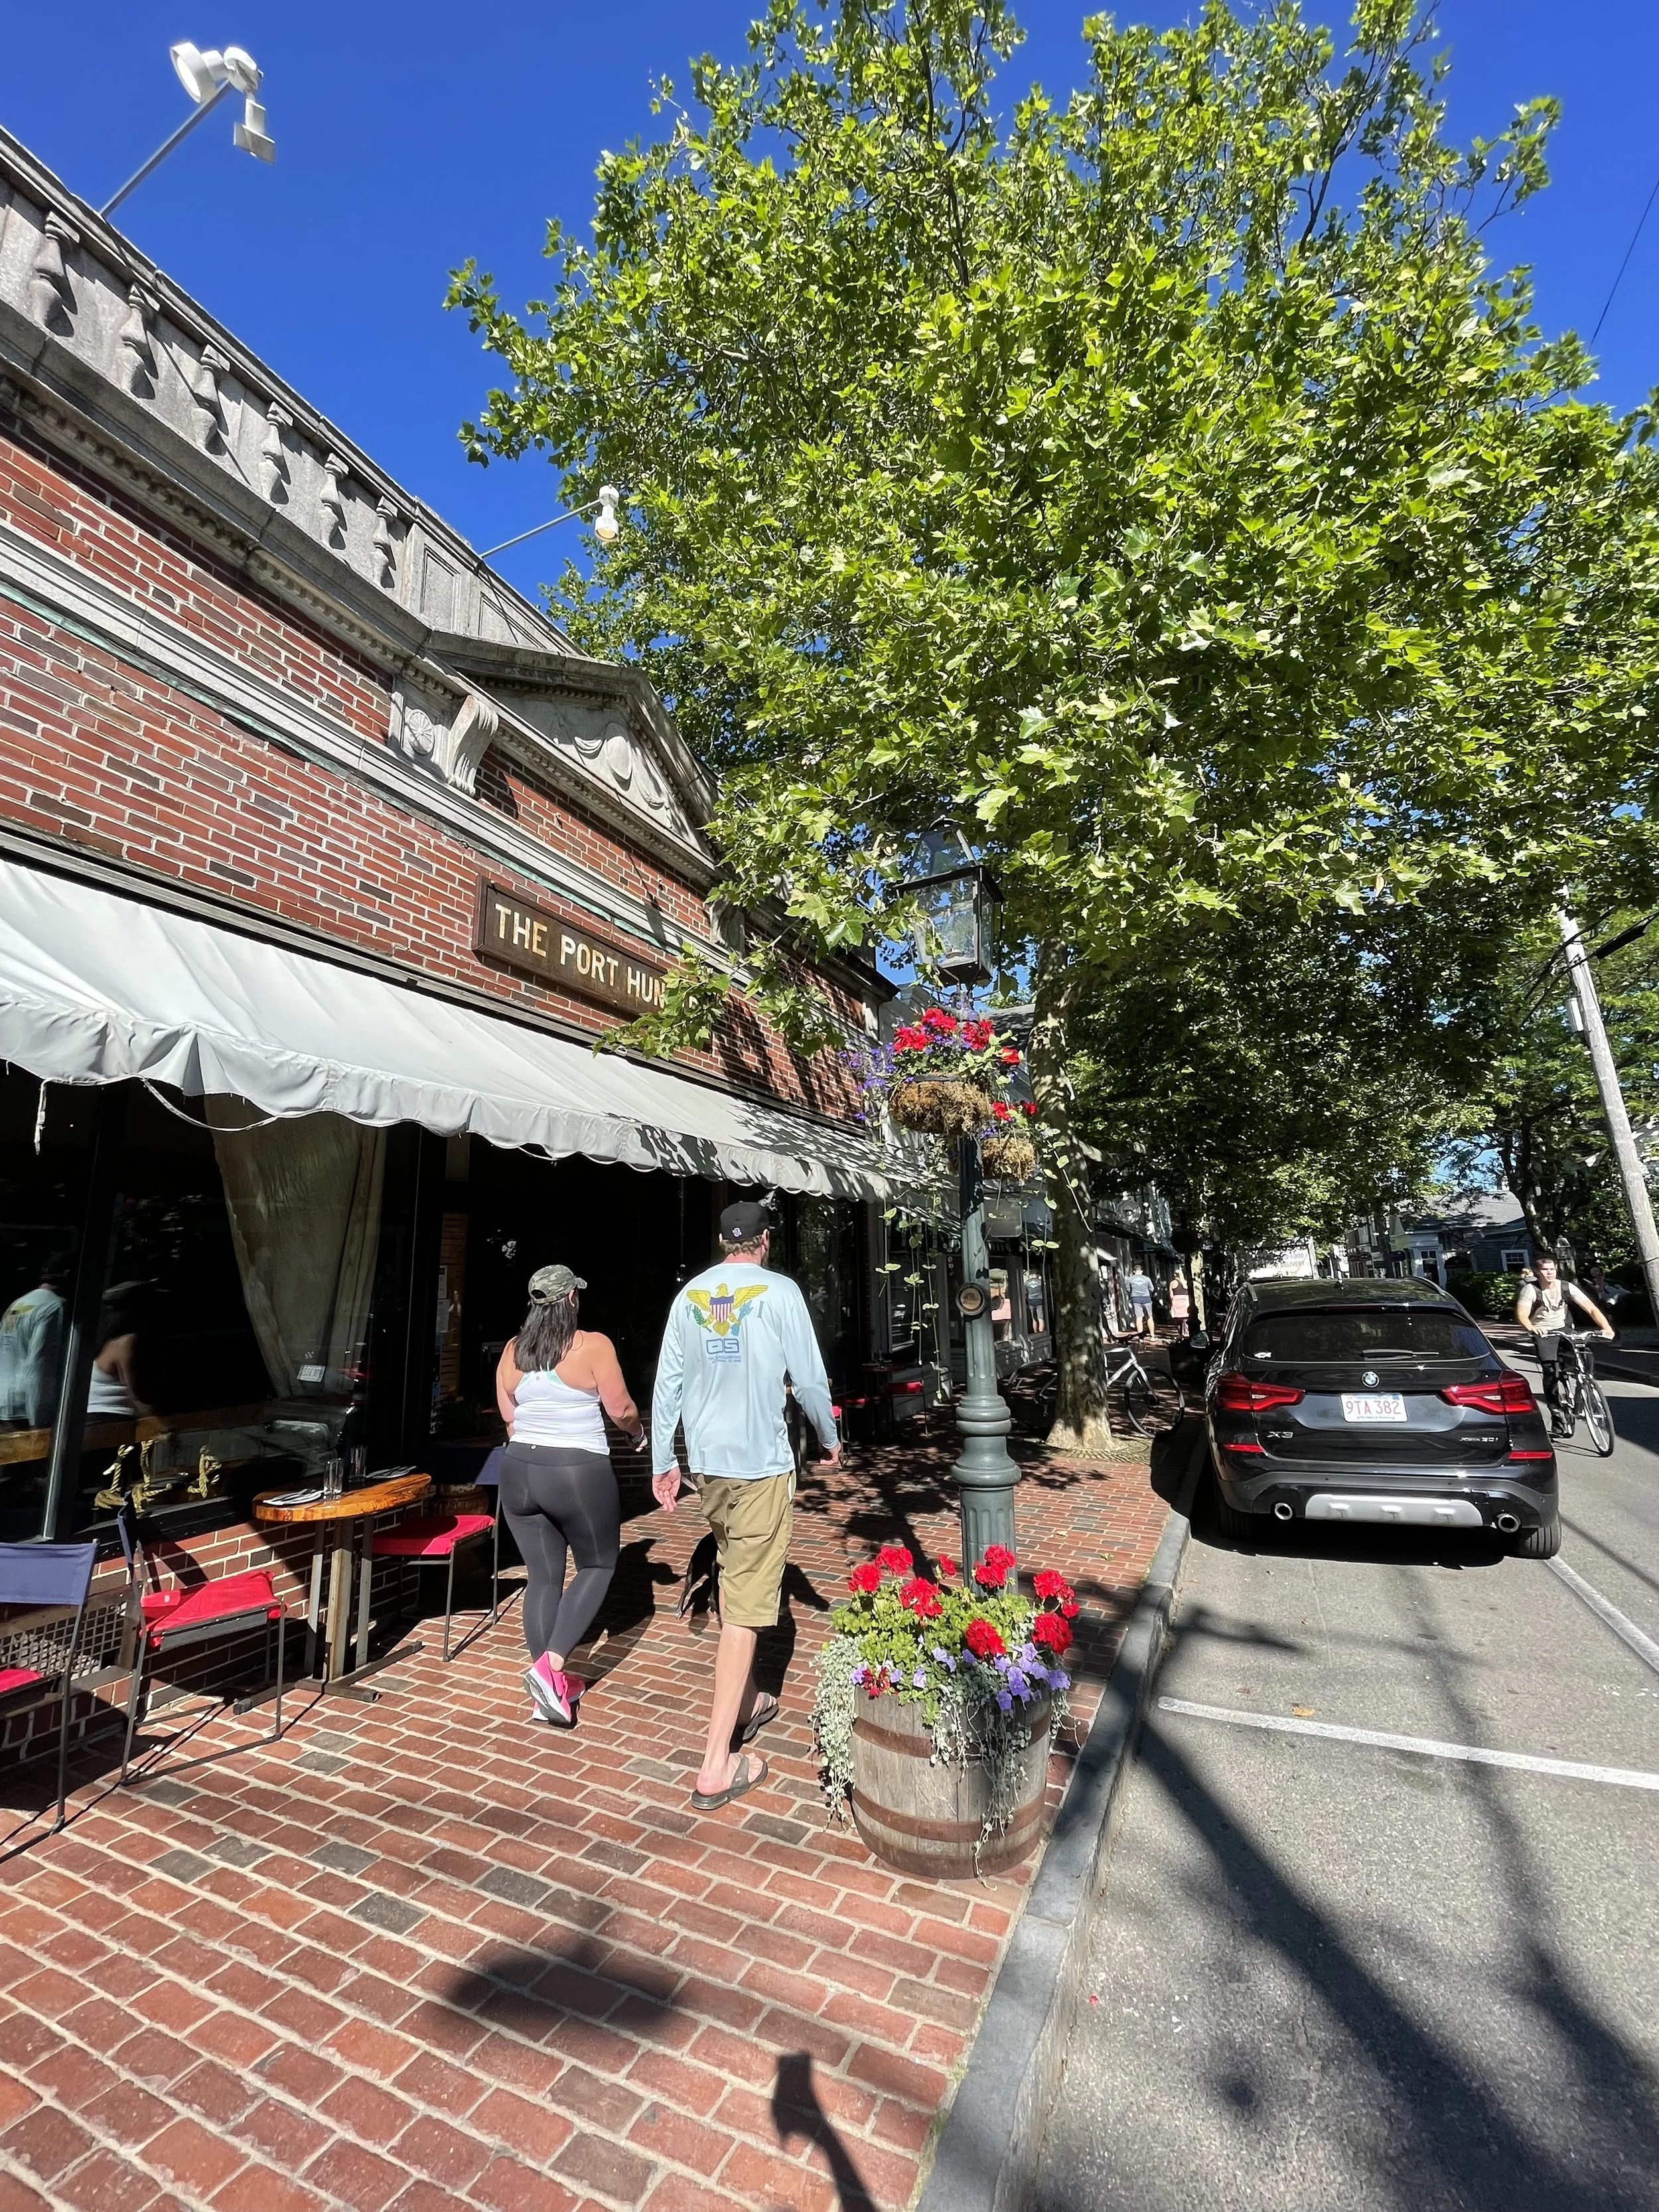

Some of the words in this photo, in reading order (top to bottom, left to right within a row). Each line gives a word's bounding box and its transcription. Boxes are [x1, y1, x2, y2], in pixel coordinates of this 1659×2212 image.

[494, 903, 547, 958] THE
[559, 934, 618, 987] PORT
[1346, 1400, 1372, 1415] 9TA
[1374, 1400, 1401, 1414] 382
